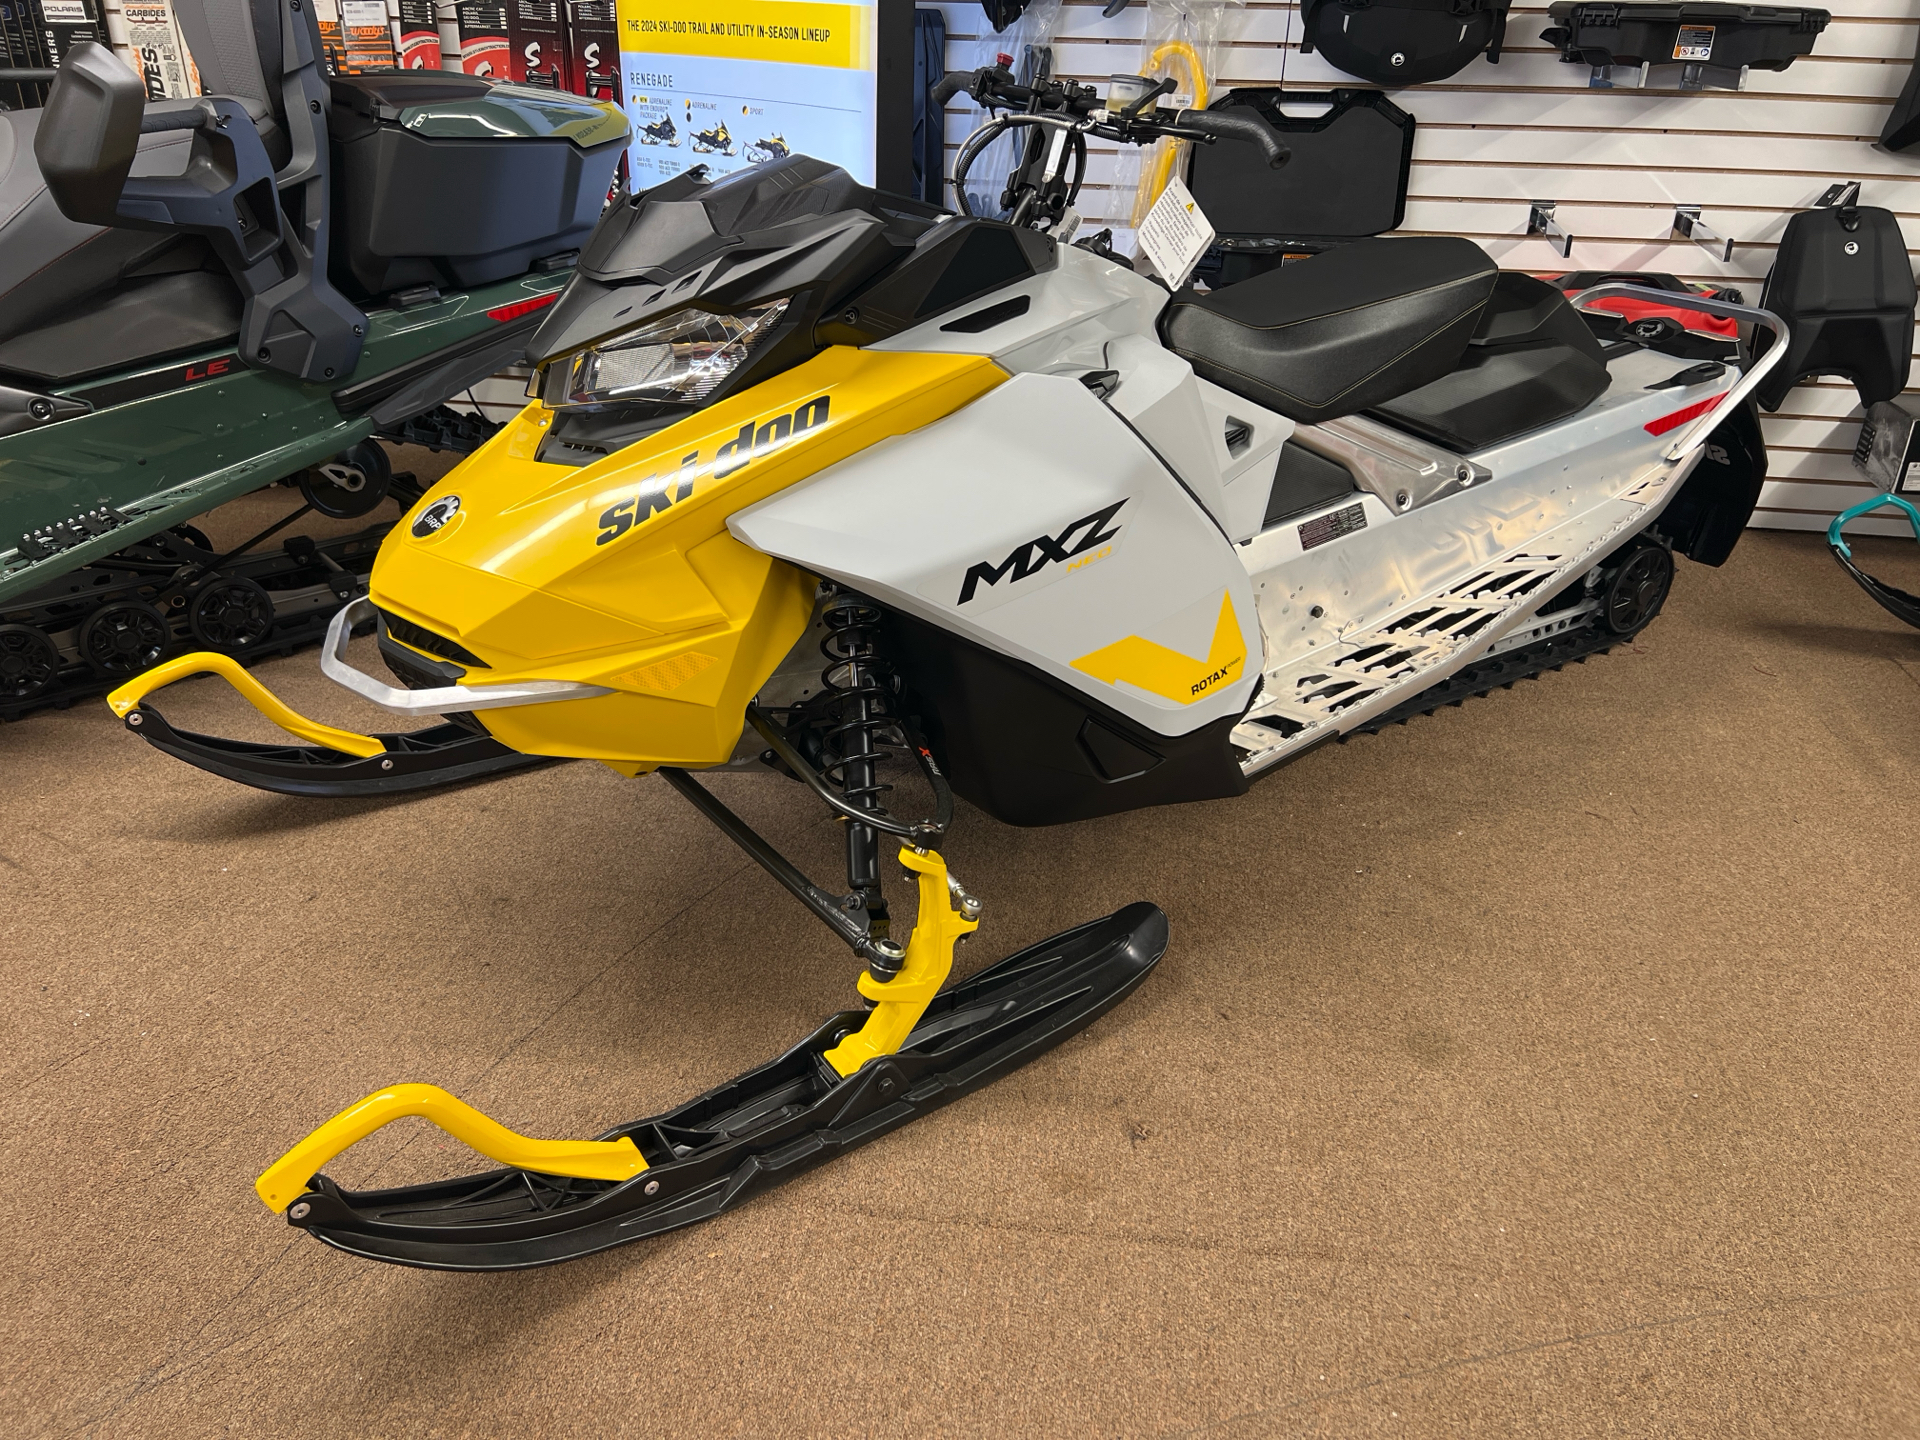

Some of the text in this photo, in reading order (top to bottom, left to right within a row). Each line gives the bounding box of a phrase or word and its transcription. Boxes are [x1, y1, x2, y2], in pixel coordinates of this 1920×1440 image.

[627, 20, 830, 43] THE 2024 SKI-DOO TRAIL AND UTILITY IN-SEASON LINEUP
[630, 72, 673, 88] RENEGADE
[649, 97, 672, 106] ADRENALINE
[692, 101, 717, 110] ADRENALINE
[750, 107, 764, 115] SPORT
[640, 111, 657, 119] PACKAGE
[186, 359, 230, 381] LE
[596, 395, 830, 546] ski-doo
[424, 514, 442, 528] BRP
[956, 496, 1131, 606] MXZ
[1066, 545, 1112, 573] NEO
[1191, 665, 1228, 695] ROTAX
